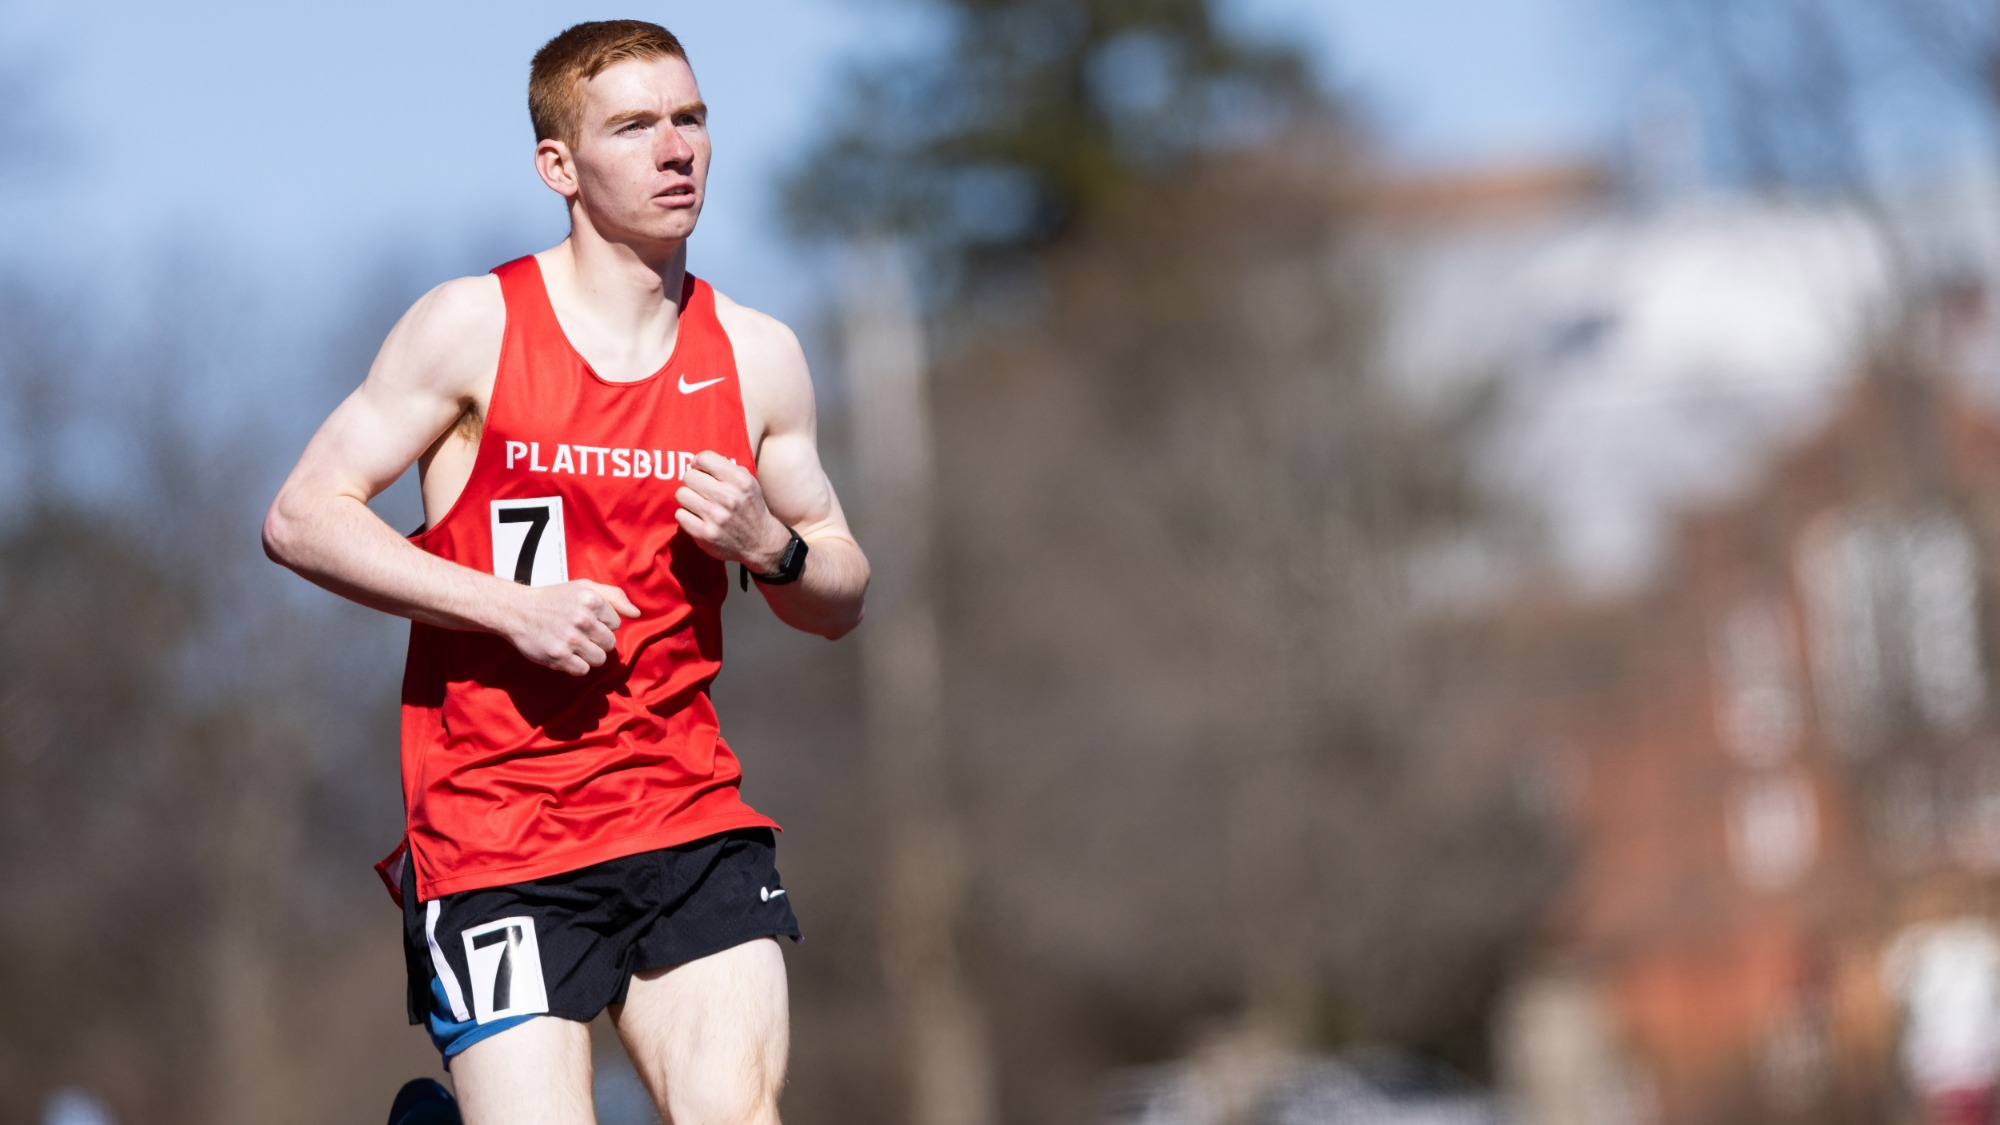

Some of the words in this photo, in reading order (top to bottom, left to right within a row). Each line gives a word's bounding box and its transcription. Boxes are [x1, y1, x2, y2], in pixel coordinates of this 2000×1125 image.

[505, 440, 737, 481] PLATTSBUR
[498, 506, 550, 586] 7
[472, 925, 523, 1012] 7
